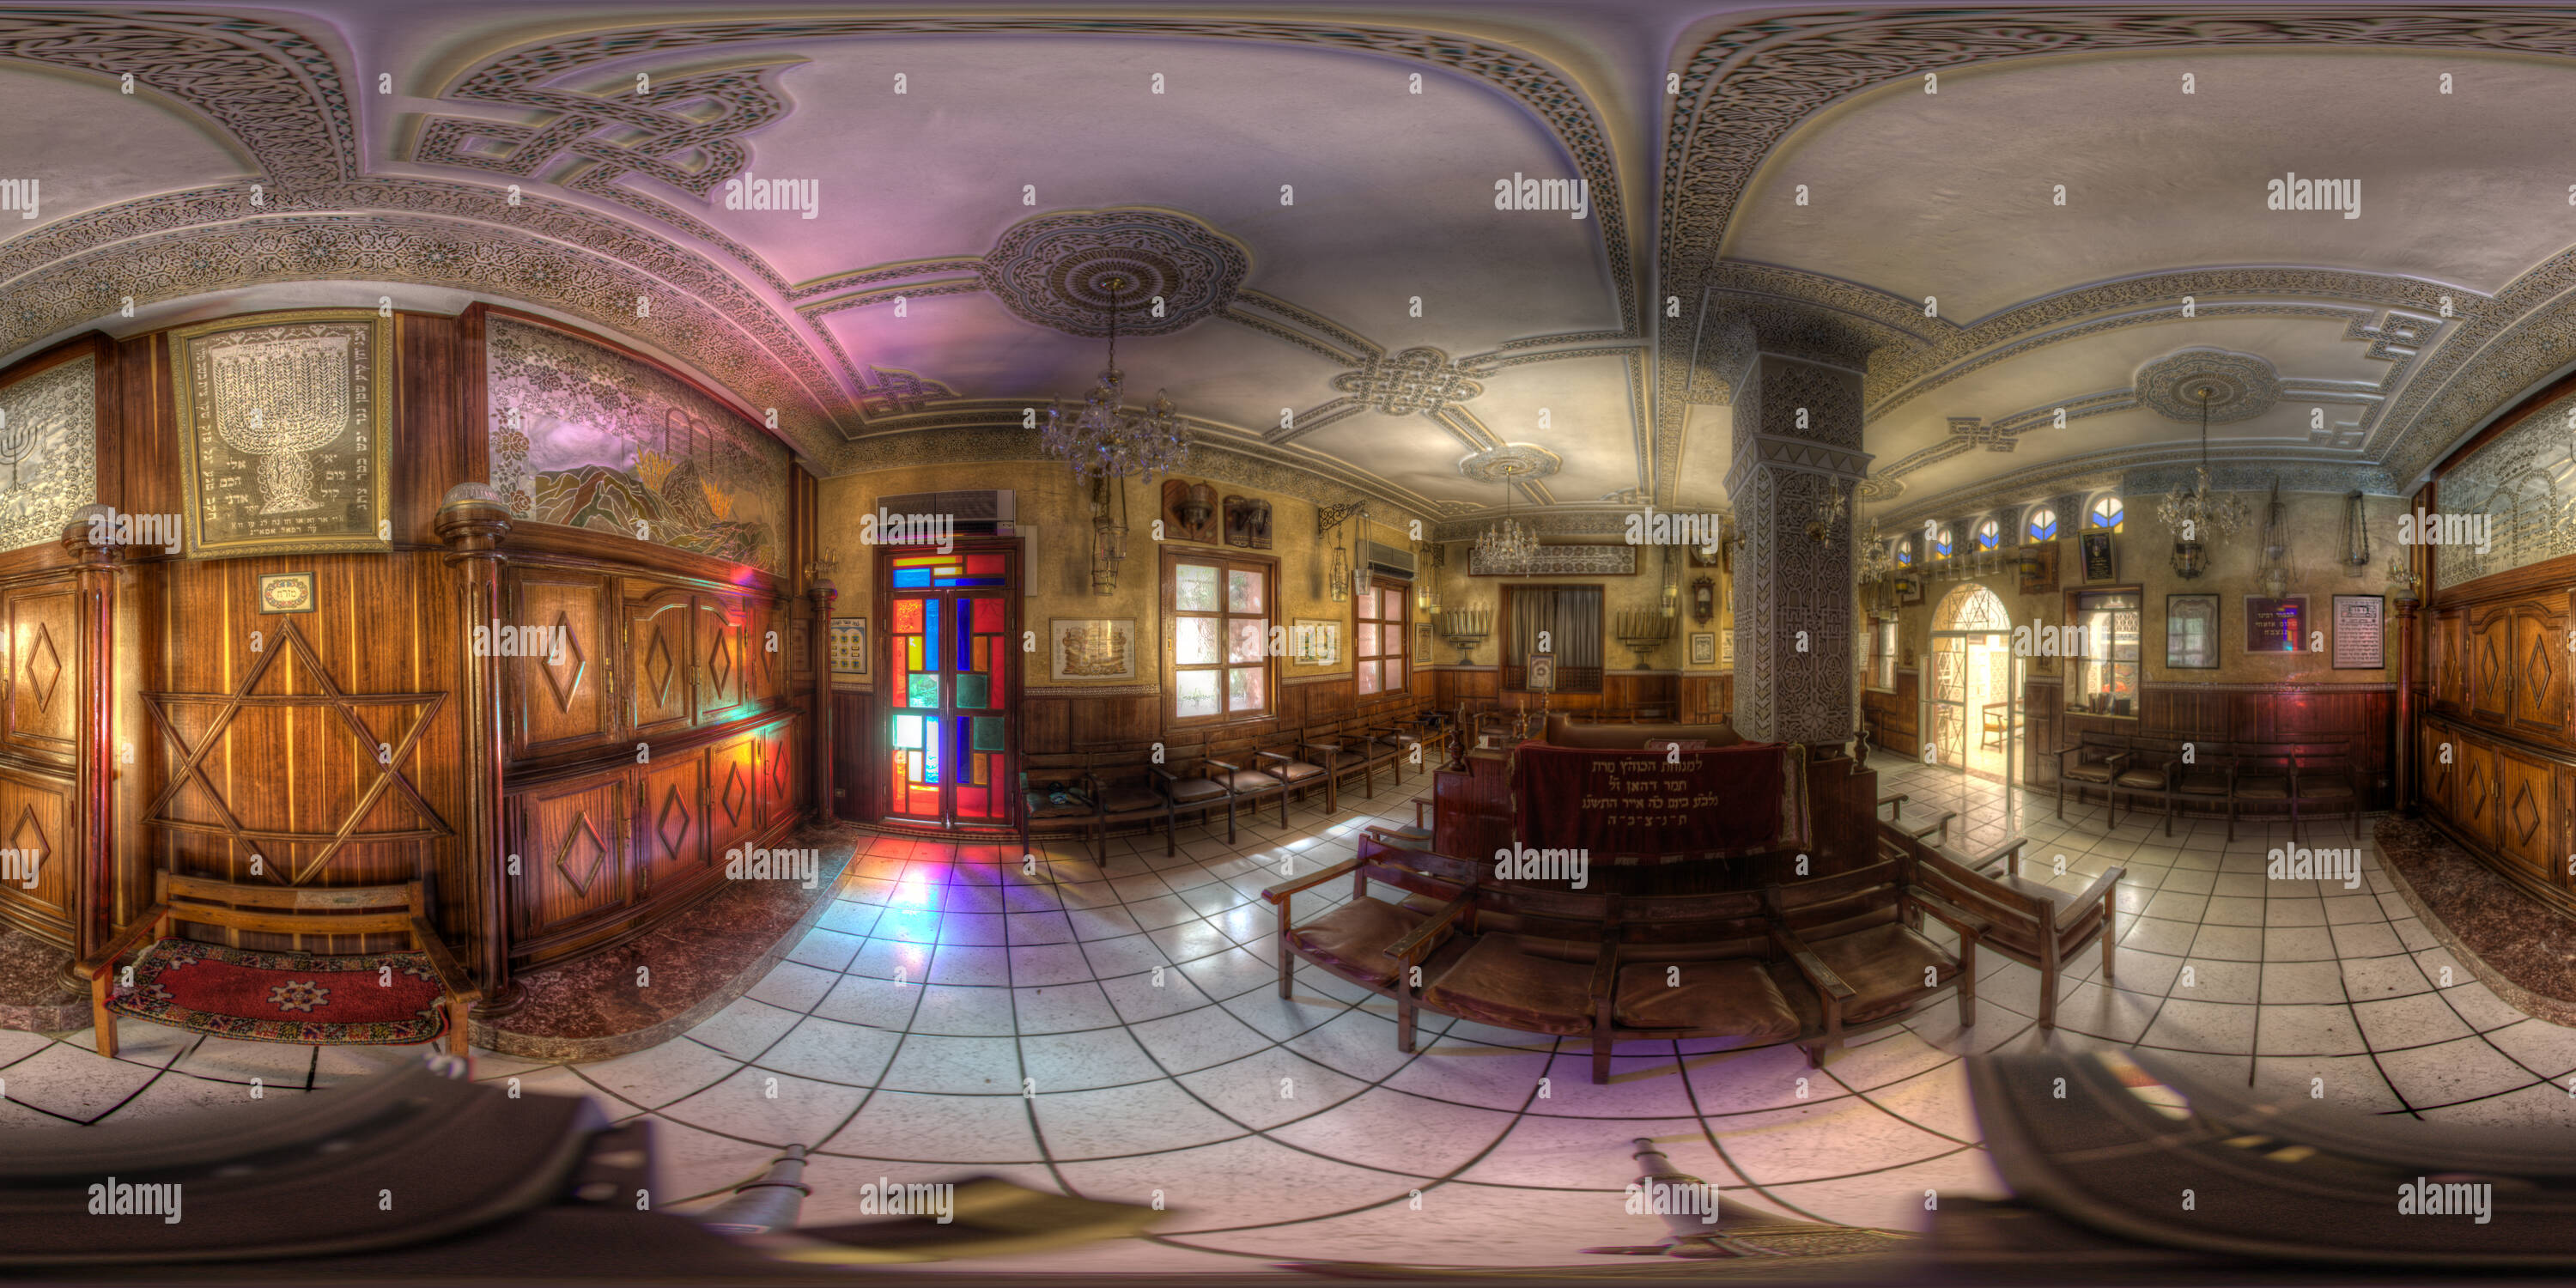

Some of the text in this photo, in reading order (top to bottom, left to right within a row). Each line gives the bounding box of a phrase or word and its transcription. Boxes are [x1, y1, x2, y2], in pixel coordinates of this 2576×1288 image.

[355, 364, 370, 381] קרע
[355, 385, 369, 403] שטן
[356, 408, 368, 425] נגד
[203, 471, 215, 491] טנע
[325, 471, 345, 480] צום
[321, 484, 340, 501] קול
[357, 488, 368, 510] צתג
[202, 496, 216, 520] חקב
[277, 589, 296, 598] מזרח
[1593, 761, 1615, 773] מרת
[1626, 781, 1657, 793] דהאן
[1664, 781, 1686, 791] תמר
